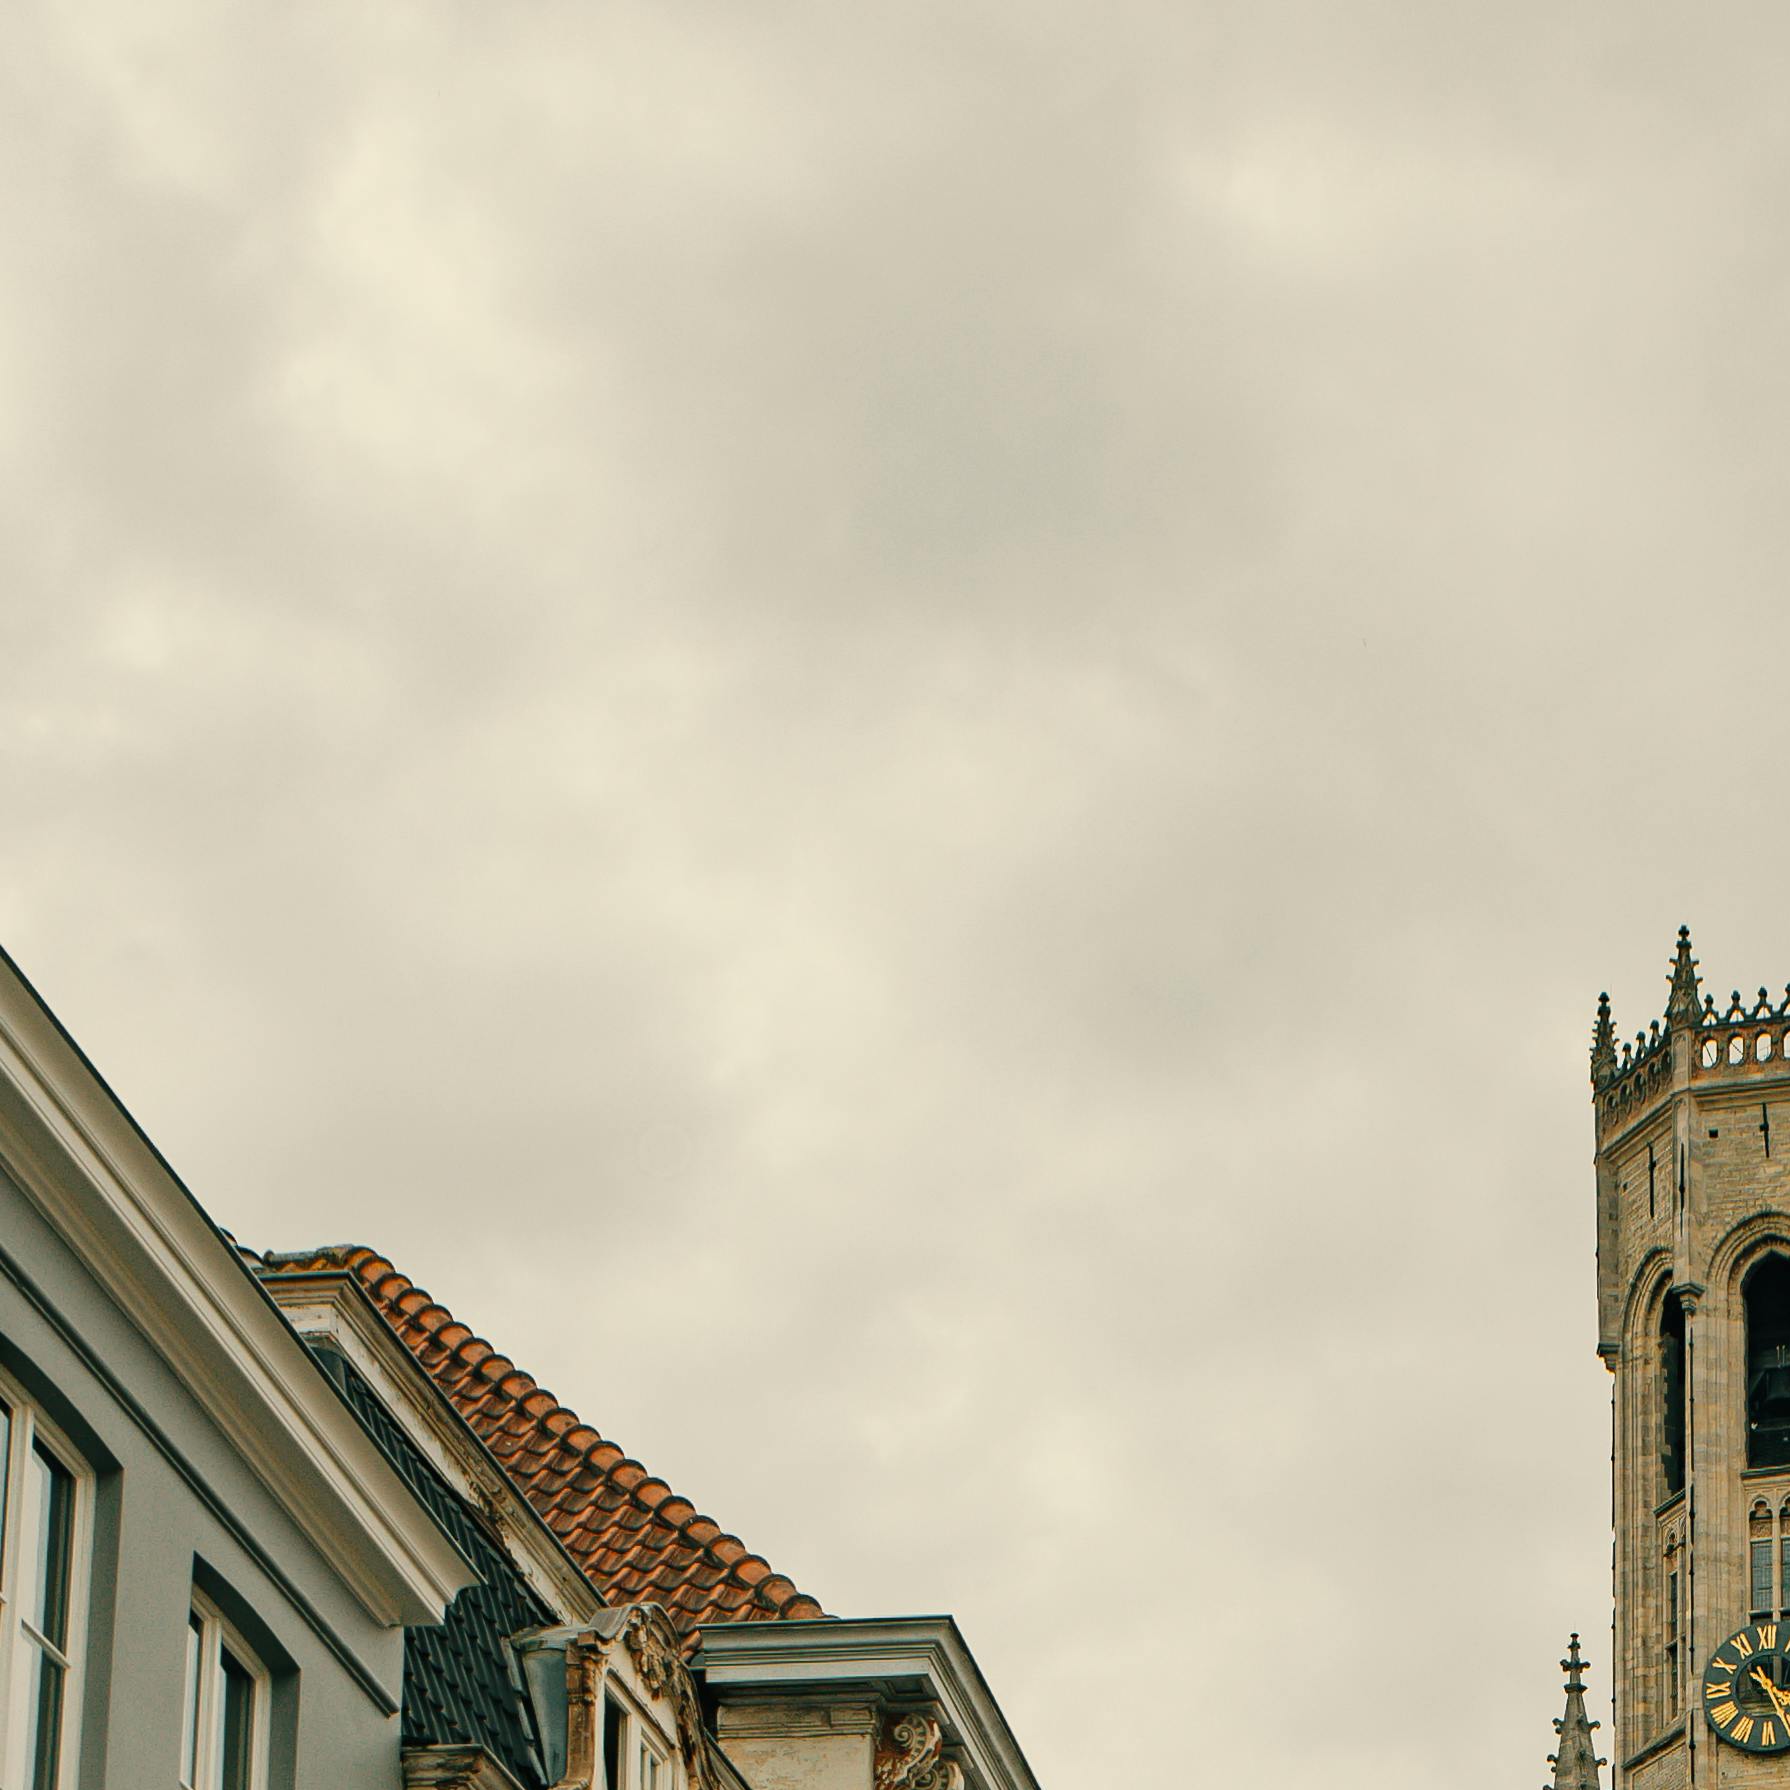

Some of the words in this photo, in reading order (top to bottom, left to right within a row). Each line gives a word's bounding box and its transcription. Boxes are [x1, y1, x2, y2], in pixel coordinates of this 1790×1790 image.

[1730, 1632, 1753, 1660] XI
[1757, 1624, 1777, 1651] XII
[1711, 1656, 1738, 1675] X
